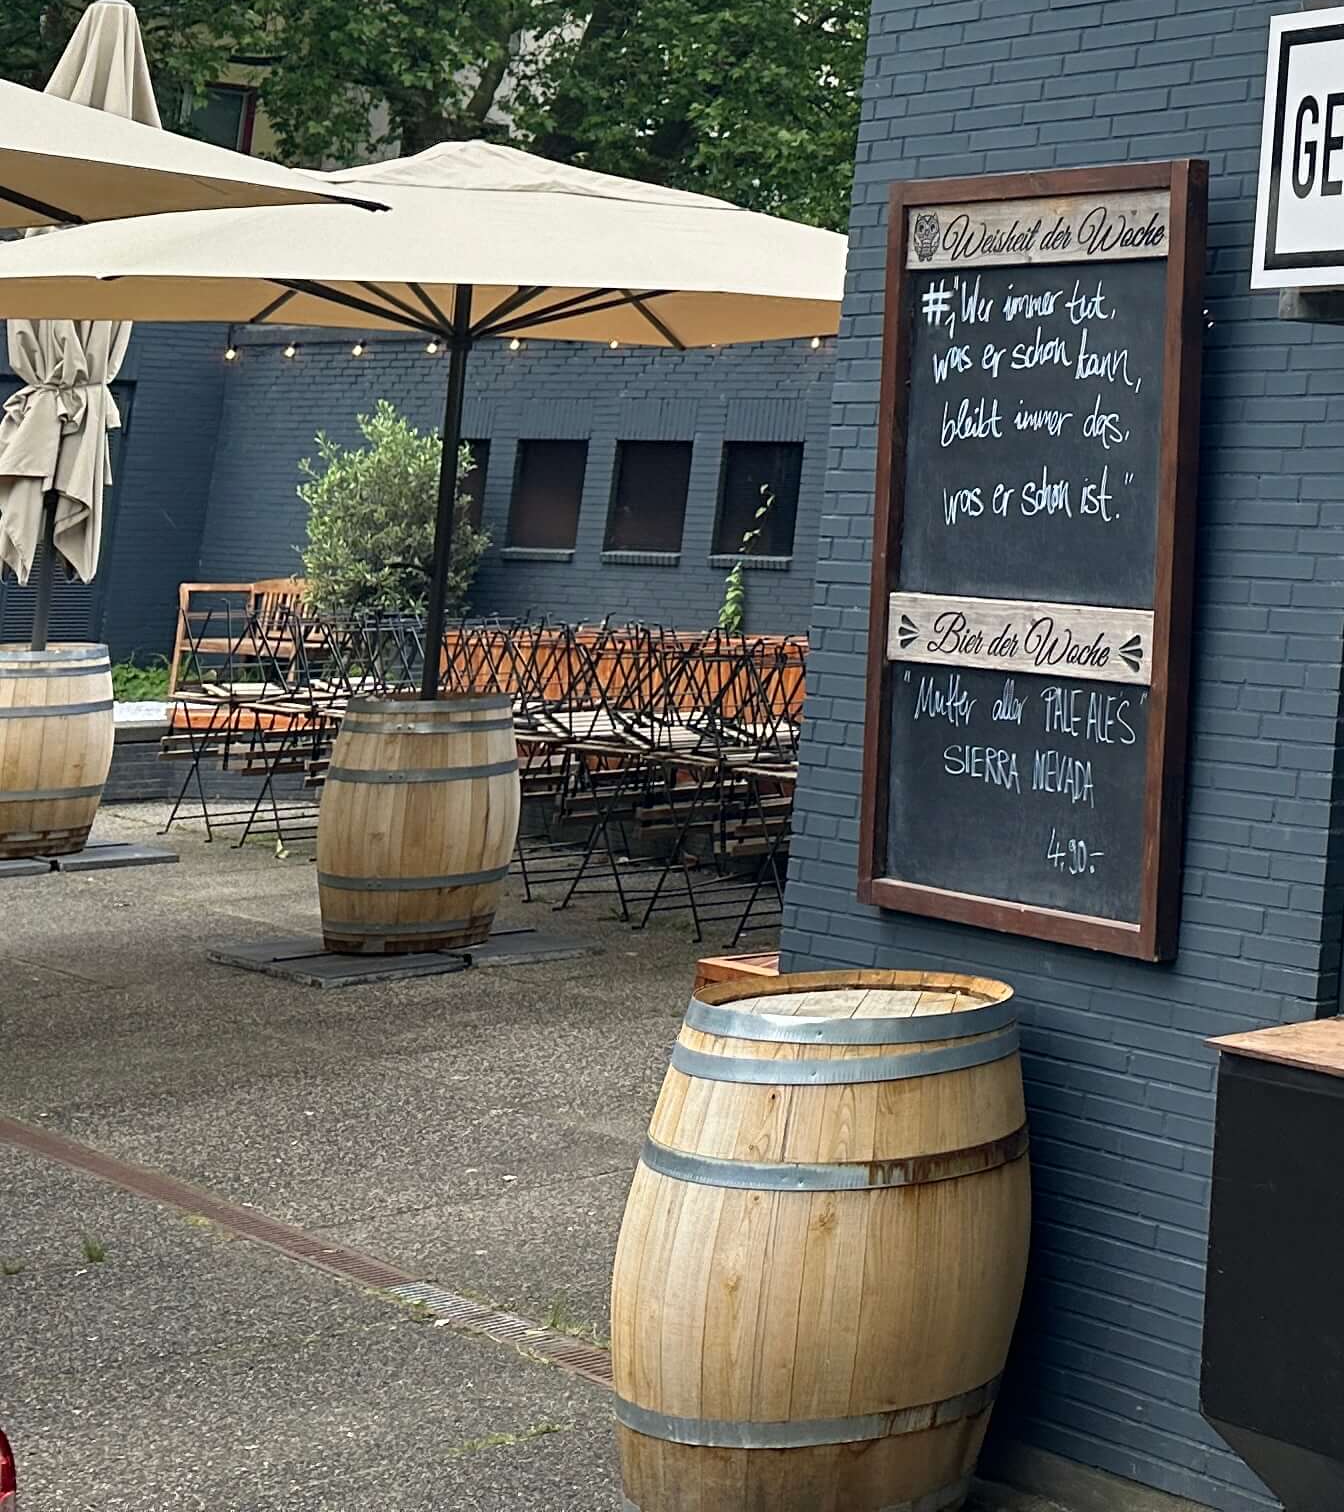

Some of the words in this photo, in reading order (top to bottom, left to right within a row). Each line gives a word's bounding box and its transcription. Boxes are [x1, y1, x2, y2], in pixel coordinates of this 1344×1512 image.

[942, 214, 1042, 262] Weisheit
[1039, 216, 1072, 251] der
[1077, 206, 1166, 256] Woche
[1003, 284, 1063, 322] immer
[932, 344, 973, 384] was
[982, 343, 1007, 378] er
[1011, 326, 1072, 369] schon
[1075, 328, 1142, 394] kann,
[940, 397, 1003, 447] bleibt
[1014, 399, 1073, 437] immer
[943, 487, 984, 526] was
[992, 483, 1015, 517] er
[1021, 465, 1072, 518] schon
[927, 611, 984, 655] Bier
[987, 623, 1019, 658] der
[1024, 616, 1112, 668] Woche
[992, 678, 1028, 725] aller
[1041, 686, 1084, 737] PALE
[943, 744, 1021, 795] SIERRA
[1032, 749, 1095, 809] NEVADA
